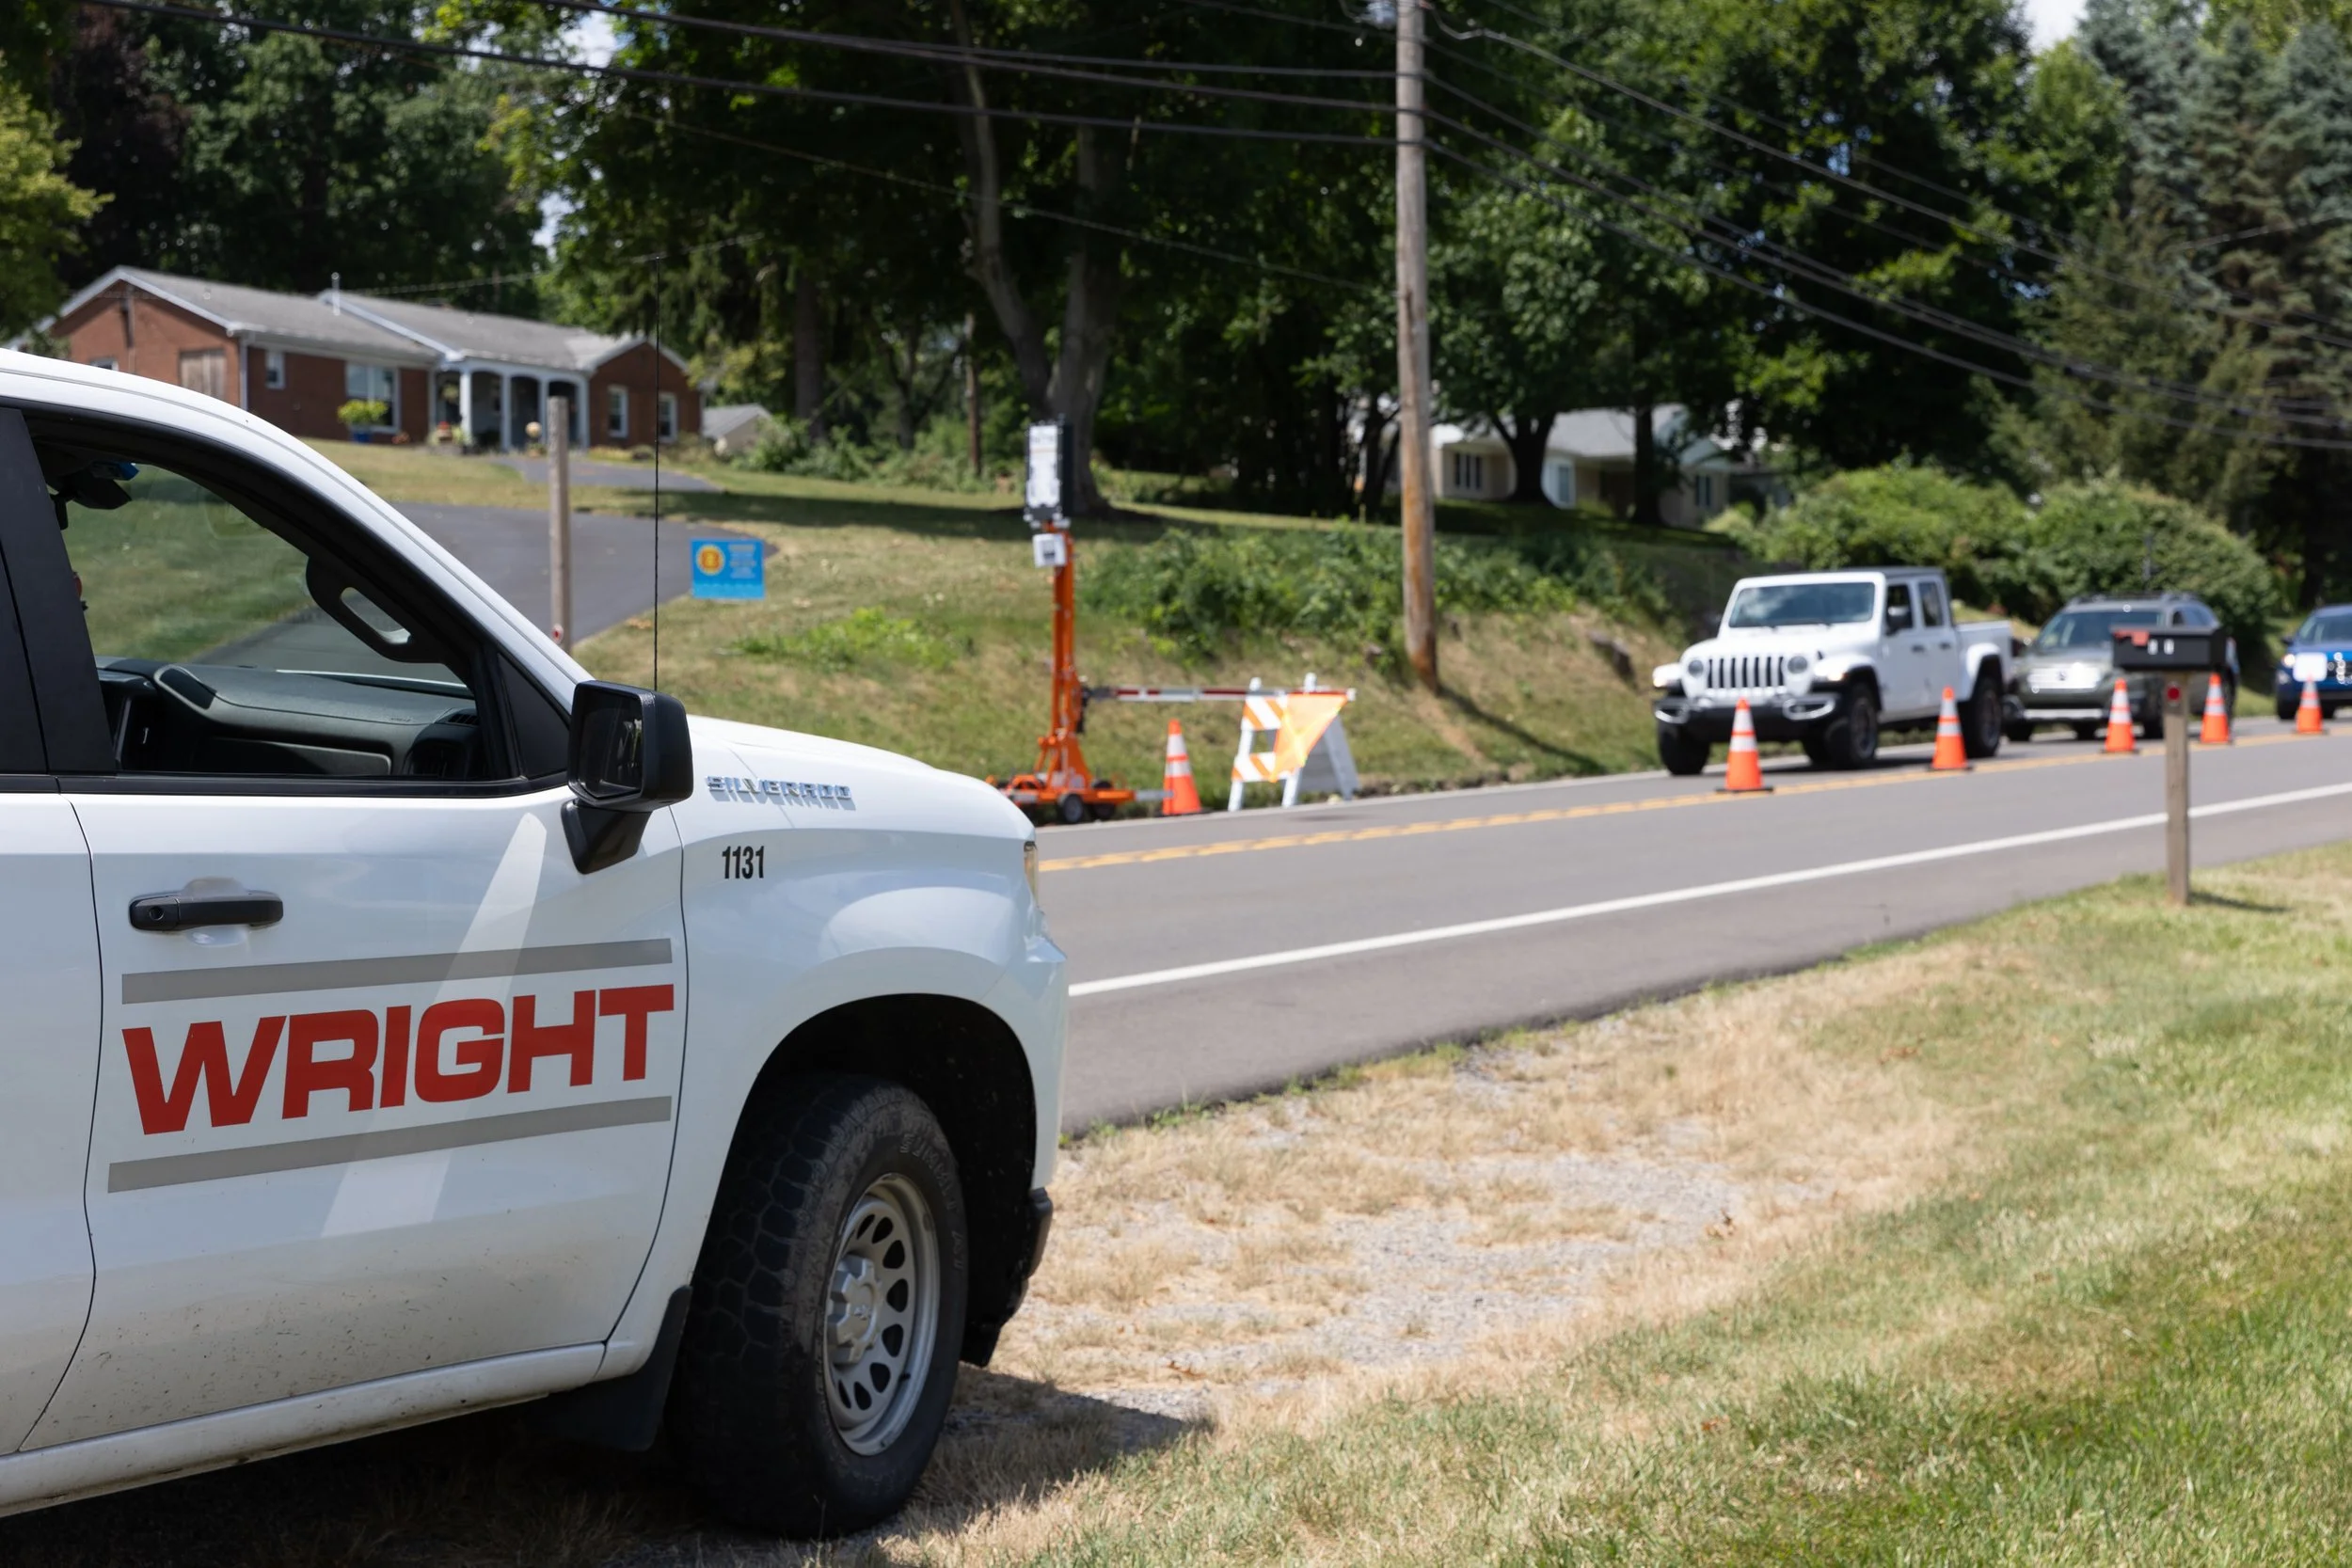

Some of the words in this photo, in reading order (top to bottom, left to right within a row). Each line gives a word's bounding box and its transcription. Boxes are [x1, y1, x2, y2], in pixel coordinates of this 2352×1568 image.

[707, 776, 851, 800] SILVERADO
[722, 846, 765, 879] 1131
[121, 984, 675, 1135] WRIGHT
